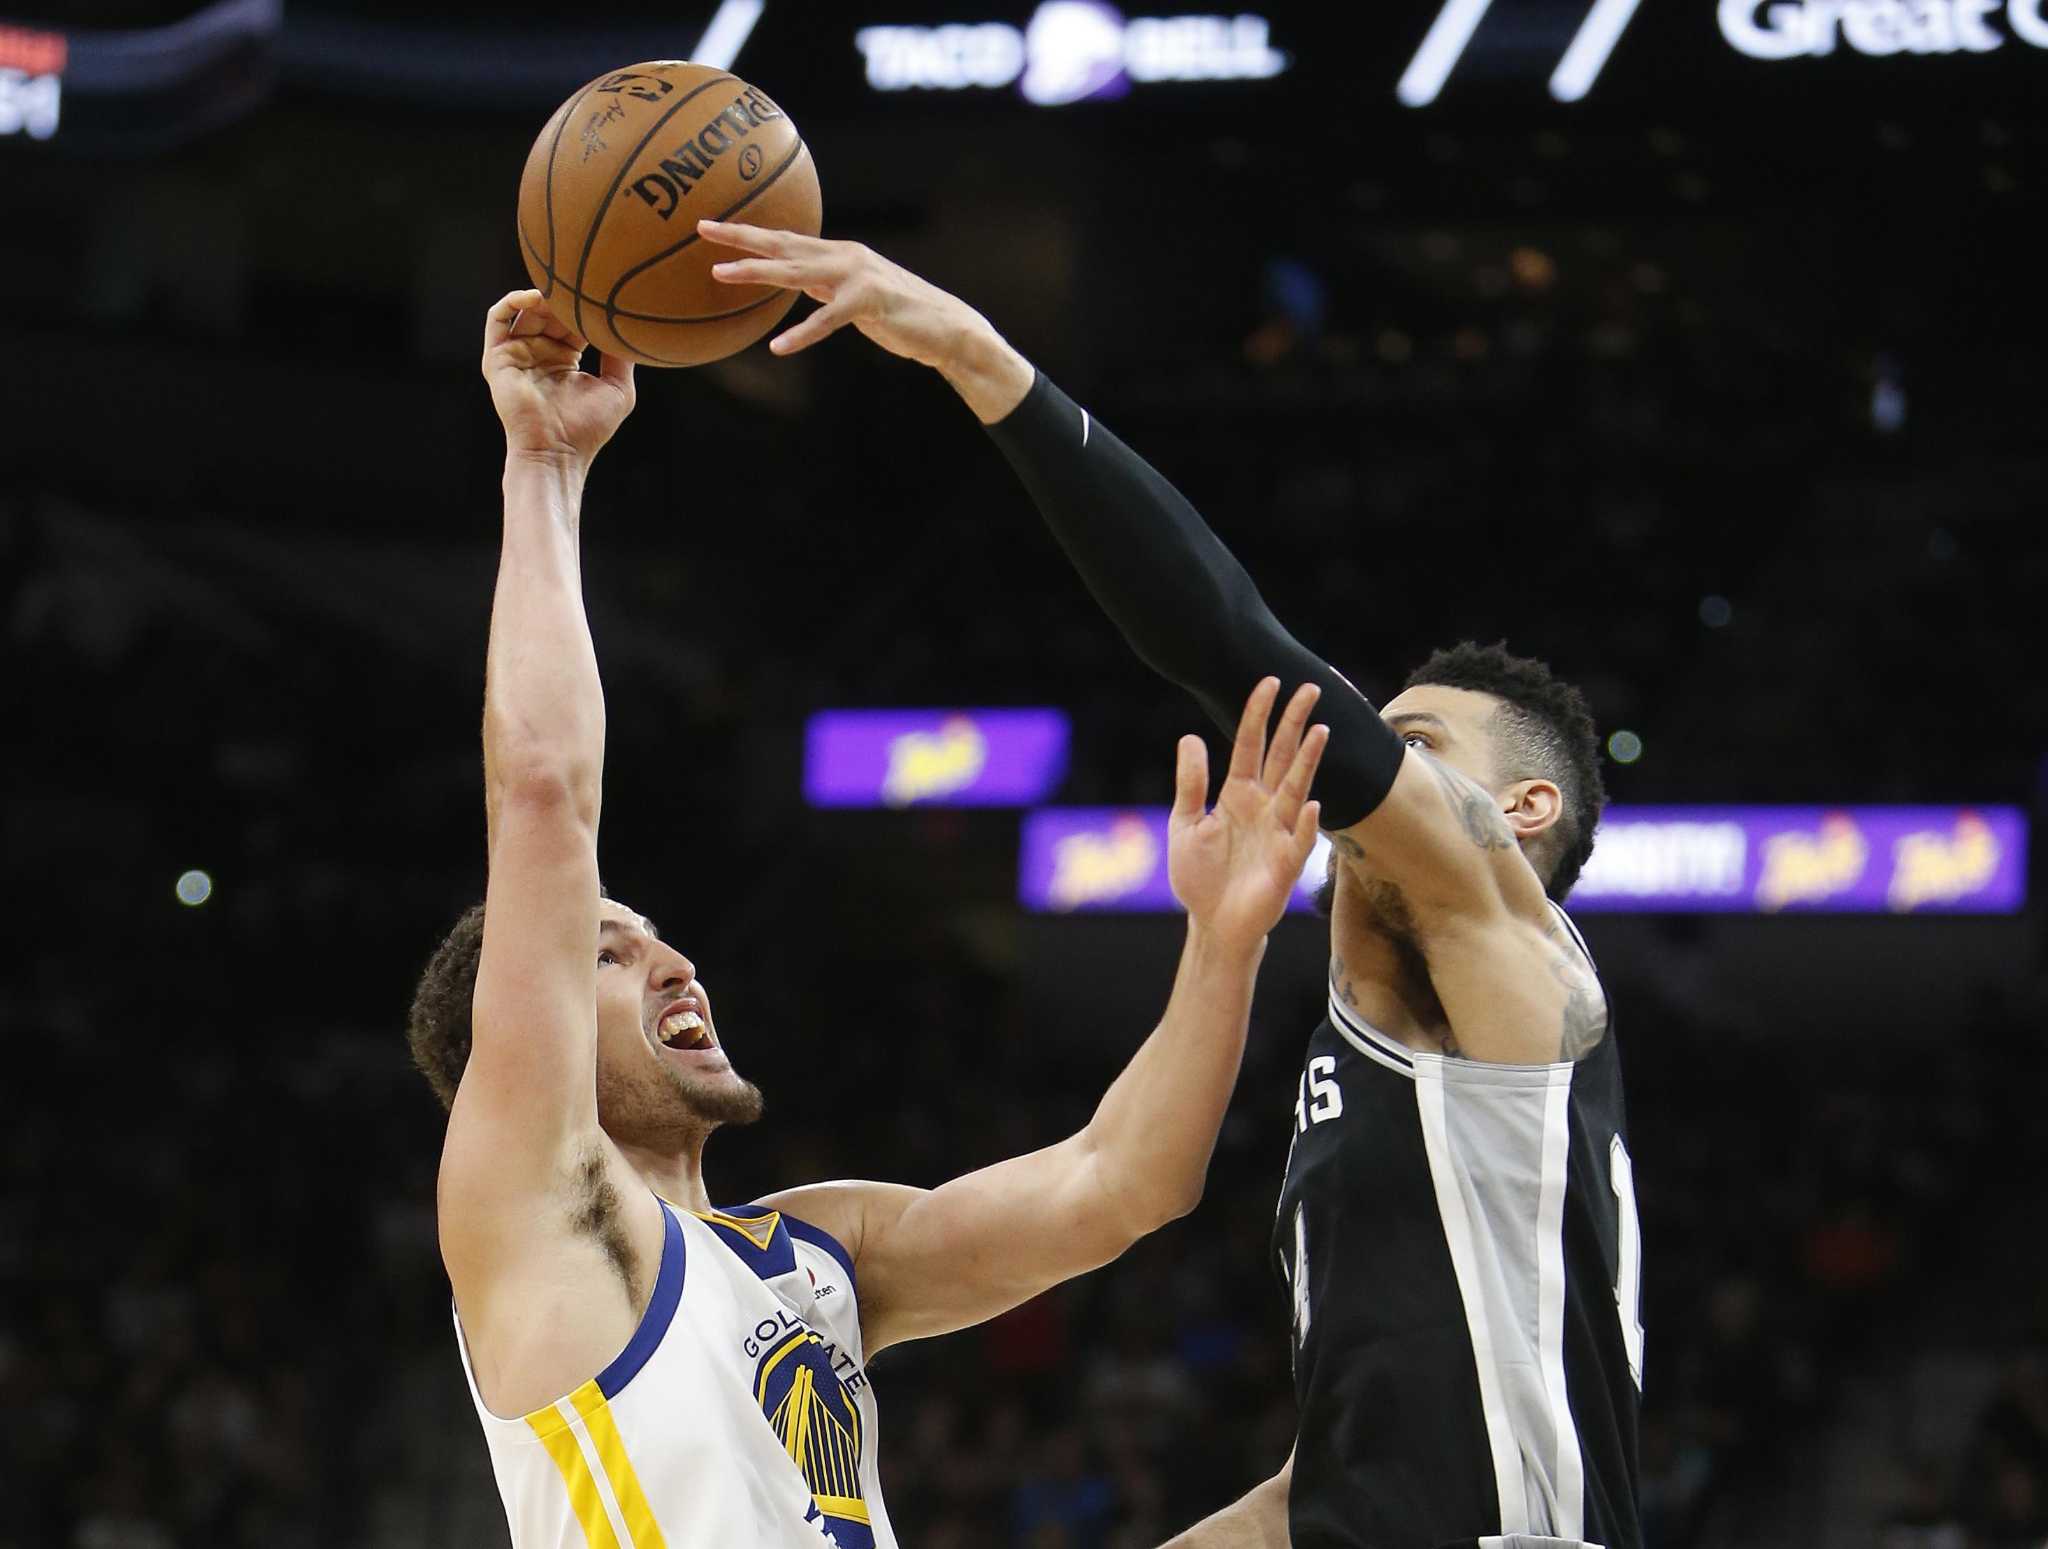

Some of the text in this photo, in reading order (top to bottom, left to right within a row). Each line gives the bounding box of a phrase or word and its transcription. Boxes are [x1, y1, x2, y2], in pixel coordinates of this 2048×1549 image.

[856, 14, 1289, 90] TACO BELL
[1718, 0, 2004, 59] Great
[744, 1310, 803, 1359] GOL
[824, 1343, 867, 1396] ATE
